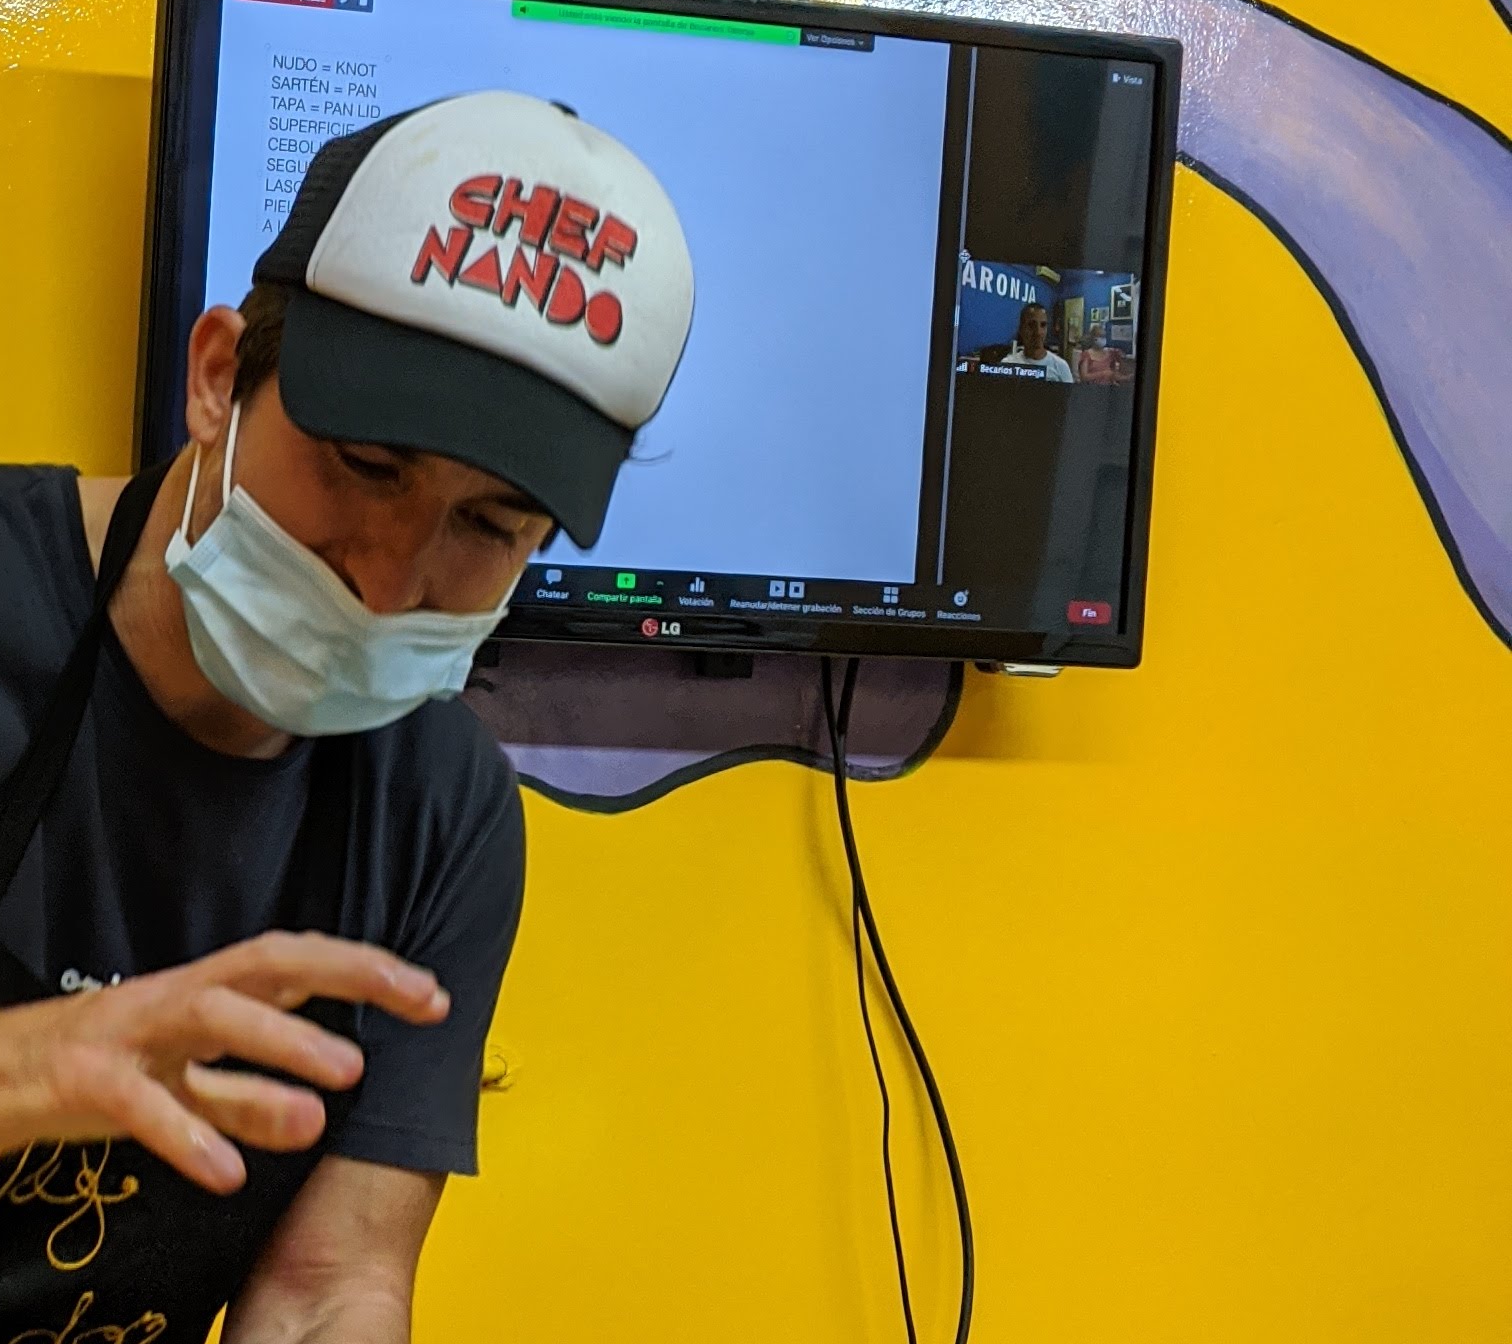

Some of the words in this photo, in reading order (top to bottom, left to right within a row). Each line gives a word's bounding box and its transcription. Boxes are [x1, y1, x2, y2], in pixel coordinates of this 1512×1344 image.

[272, 54, 317, 72] NUDO
[322, 64, 331, 72] =
[336, 61, 377, 78] KNOT
[271, 75, 329, 94] SARTÉN
[334, 85, 343, 94] =
[348, 83, 377, 99] PAN
[270, 96, 306, 112] TAPA
[311, 104, 320, 113] =
[324, 101, 354, 117] PAN
[358, 105, 381, 119] LID
[261, 218, 273, 233] A
[449, 174, 639, 276] CHEF
[410, 223, 623, 345] NANDO
[962, 259, 1037, 304] ARONJA
[980, 364, 1012, 375] Becarios
[1014, 366, 1045, 378] Taronja
[536, 589, 570, 600] Chatear
[587, 591, 628, 603] Compartir
[629, 594, 662, 605] pantalla
[678, 596, 715, 607] Votación
[802, 603, 843, 614] grabación
[852, 605, 885, 616] Sección
[885, 607, 896, 617] de
[897, 608, 926, 619] Grupos
[1082, 608, 1097, 618] Fin
[936, 610, 982, 622] Reacciones
[660, 621, 681, 636] LG
